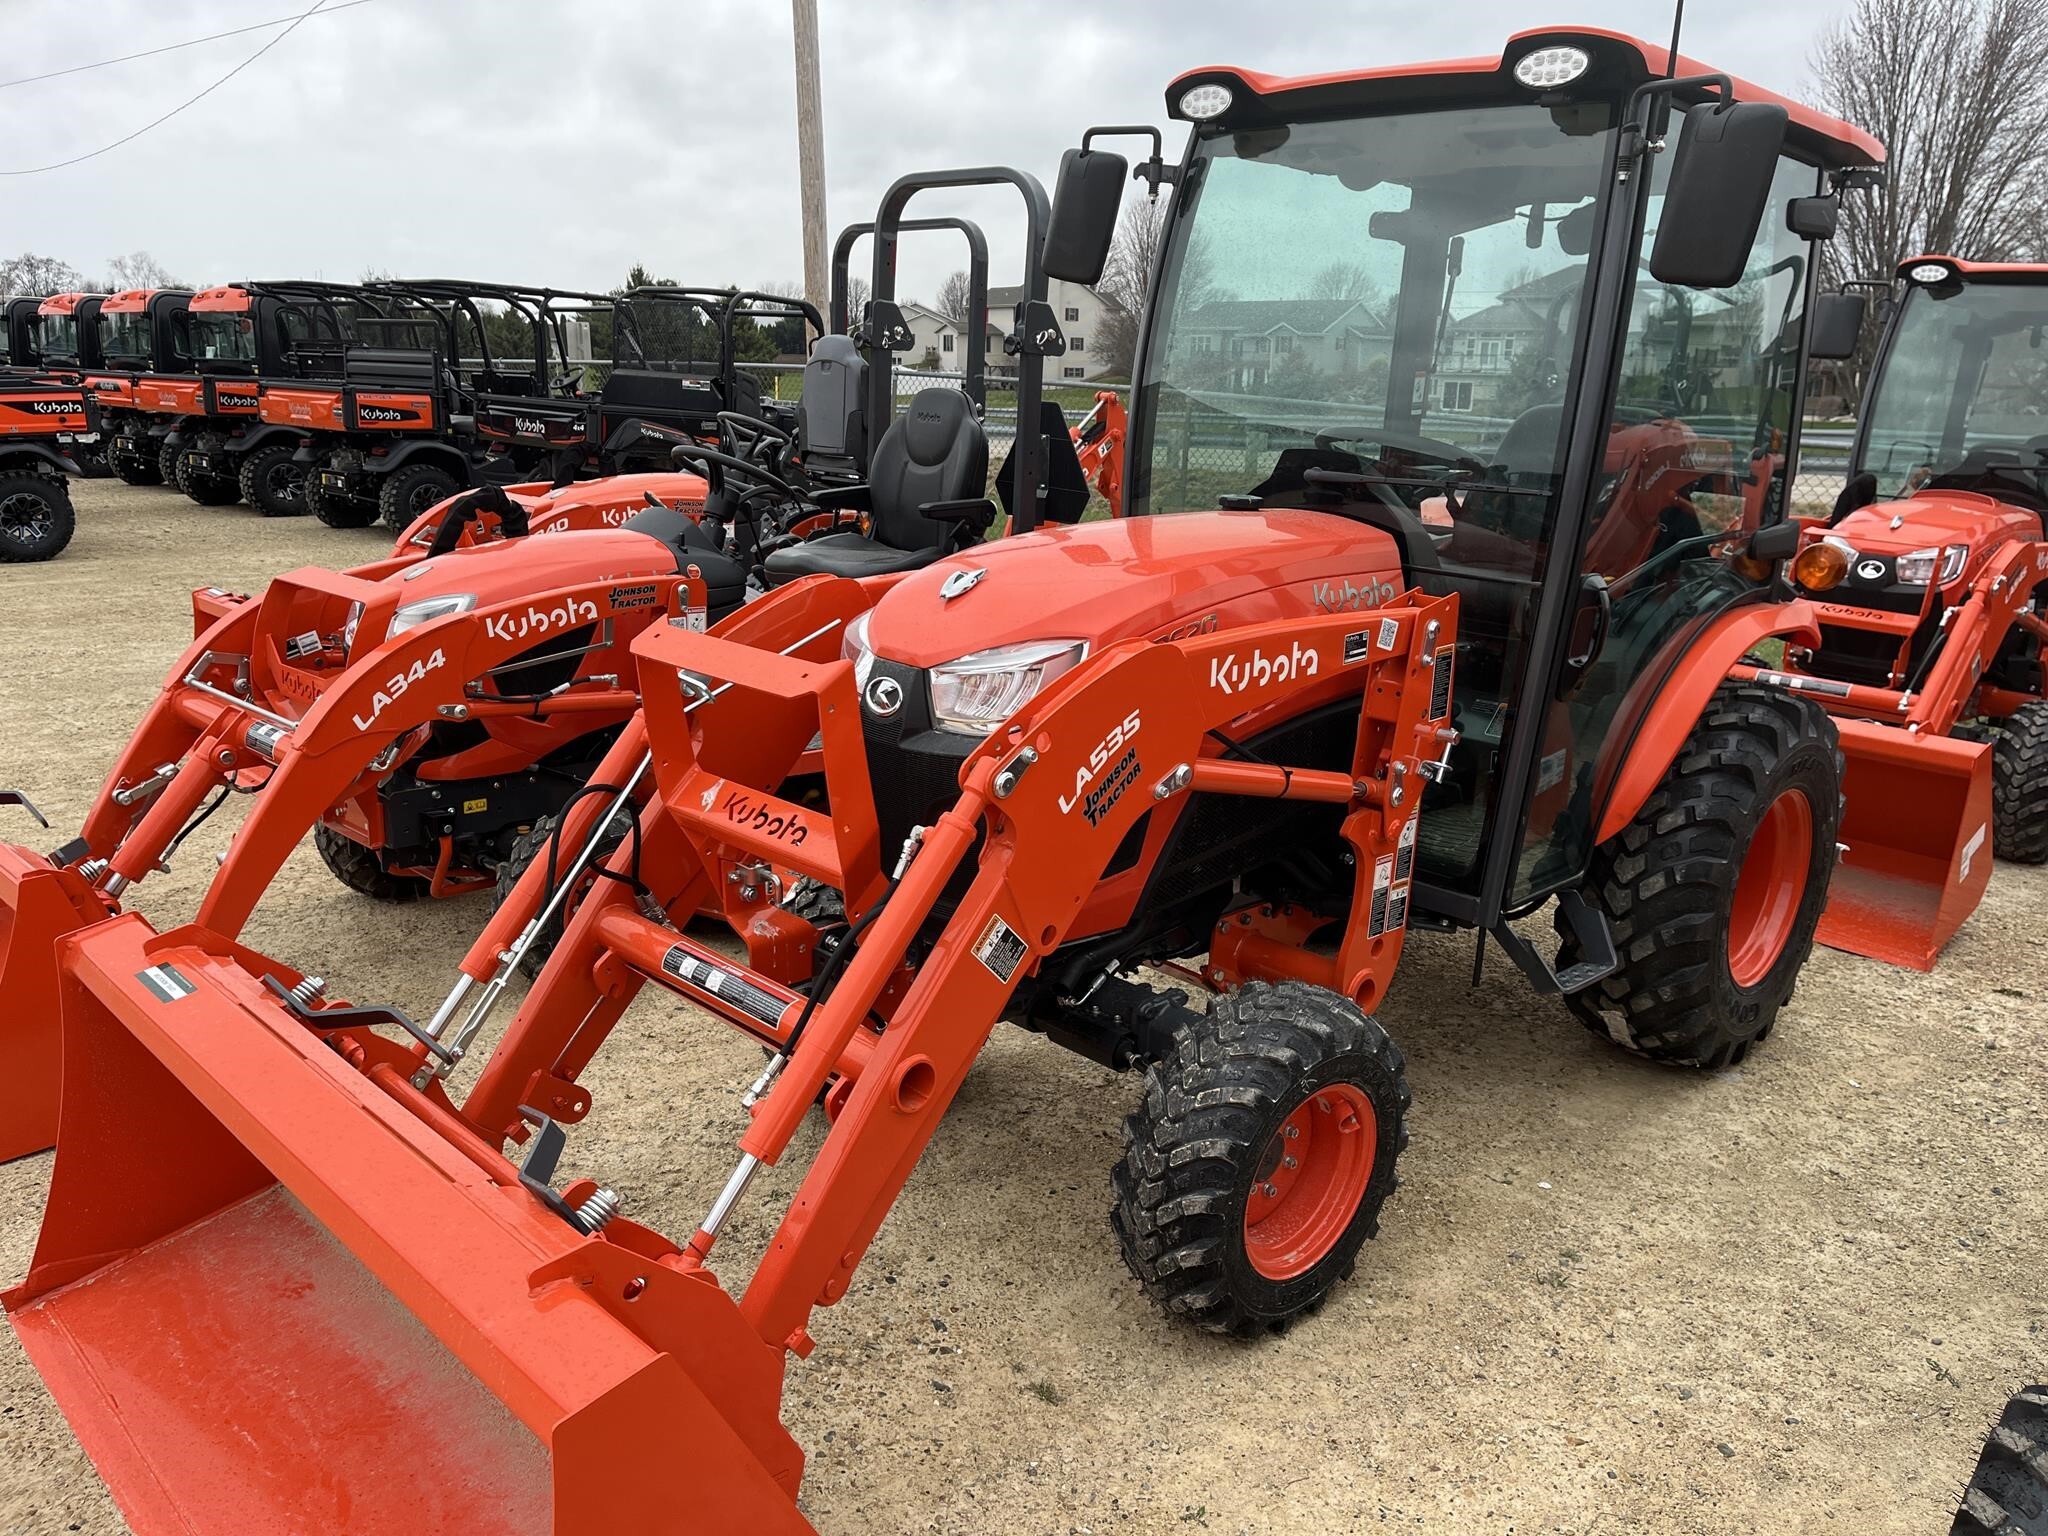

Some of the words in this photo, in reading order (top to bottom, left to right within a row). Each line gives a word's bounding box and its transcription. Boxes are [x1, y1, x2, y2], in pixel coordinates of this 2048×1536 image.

[34, 402, 82, 413] Kubota
[220, 395, 258, 406] Kubota
[361, 408, 401, 420] Kubota
[515, 417, 546, 434] Kubota
[641, 427, 664, 440] Kubota
[609, 585, 656, 599] JOHNSON
[610, 596, 656, 609] TRACTOR
[1313, 576, 1395, 613] Kubota
[486, 597, 598, 641] Kubota
[1820, 604, 1884, 620] Kubota
[1210, 641, 1319, 694] Kubota
[352, 648, 446, 731] LA344
[1058, 709, 1141, 814] LA535
[1083, 748, 1136, 816] JOHNSON
[1088, 763, 1141, 827] TRACTOR
[722, 791, 808, 846] Kubota
